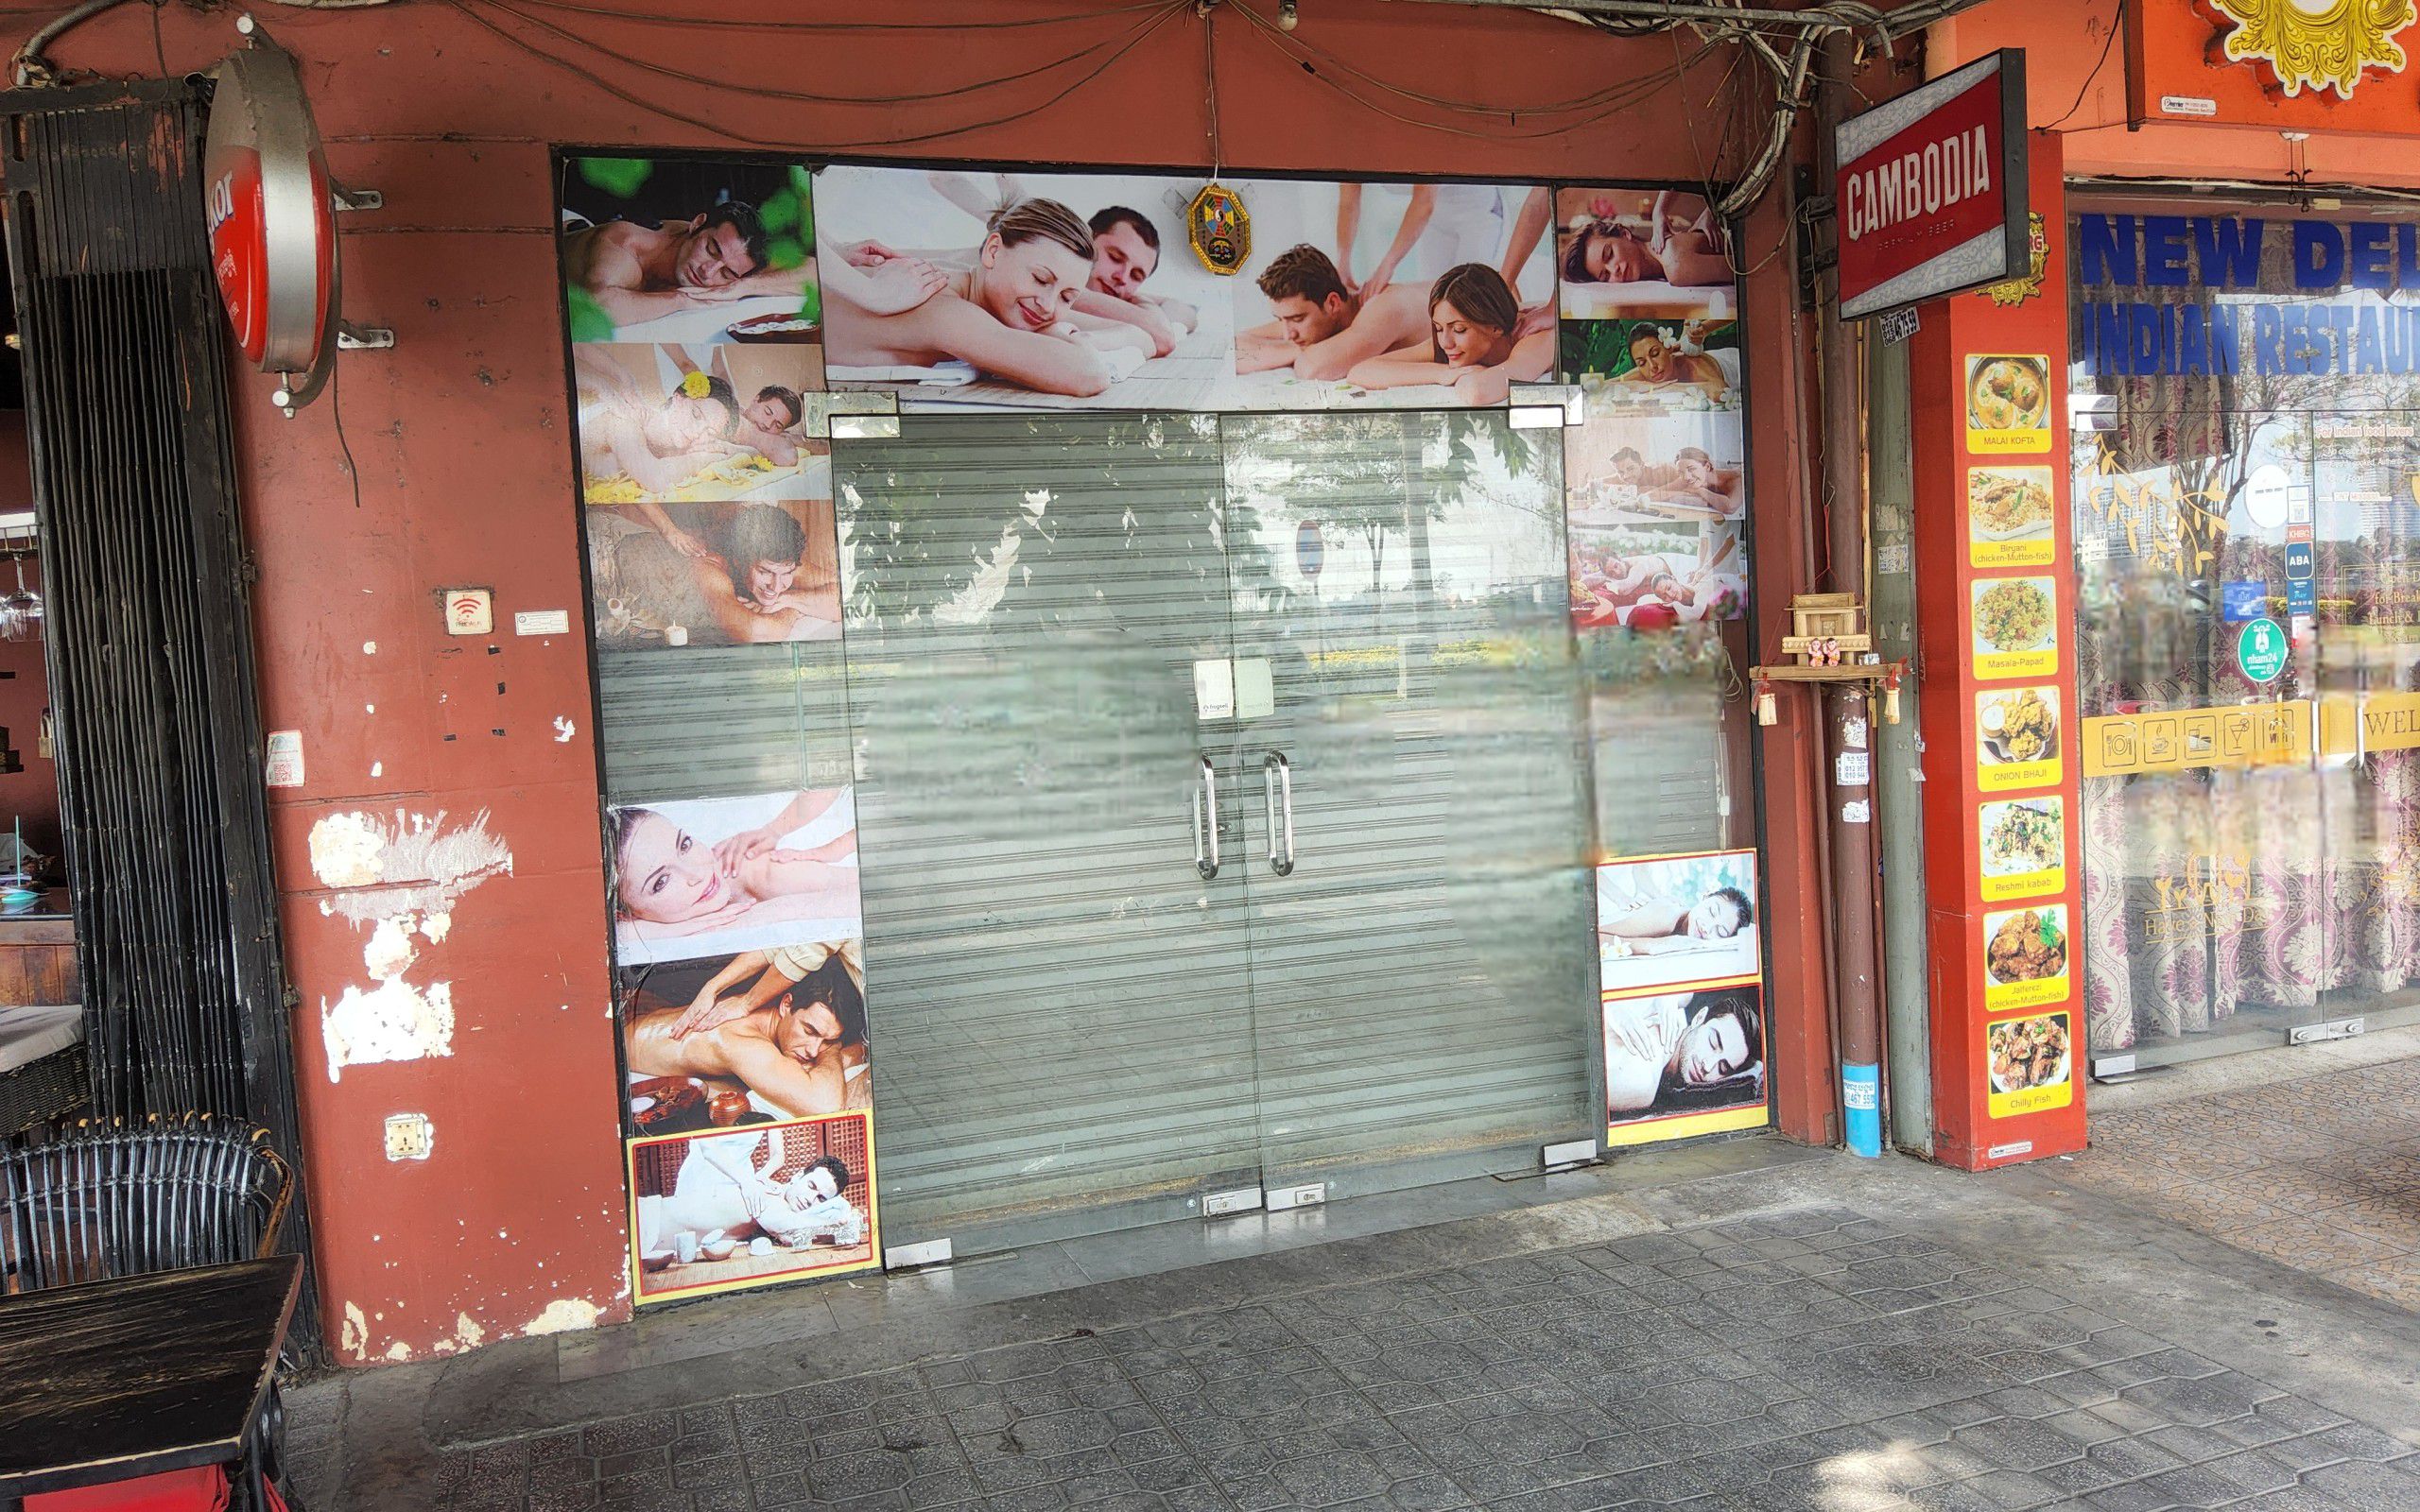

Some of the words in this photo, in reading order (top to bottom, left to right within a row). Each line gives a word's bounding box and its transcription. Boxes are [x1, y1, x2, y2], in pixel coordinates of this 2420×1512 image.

[1848, 124, 1990, 242] CAMBODIA
[2081, 214, 2265, 287] NEW
[2083, 302, 2240, 376] INDIAN
[2334, 425, 2362, 437] Indian
[2363, 423, 2385, 436] food
[1984, 437, 2009, 445] MALAI
[2000, 544, 2027, 556] Biryani
[1975, 552, 2052, 563] (chicken-Mutton-fish)
[2290, 555, 2309, 566] ABA
[1988, 658, 2044, 669] Masala-Papad
[2247, 652, 2278, 664] nham24
[1994, 771, 2021, 782] ONION
[2023, 769, 2047, 780] BHAJI
[1996, 880, 2025, 892] Reshmi
[2010, 1095, 2031, 1108] Chilly
[2034, 1093, 2051, 1105] Fish
